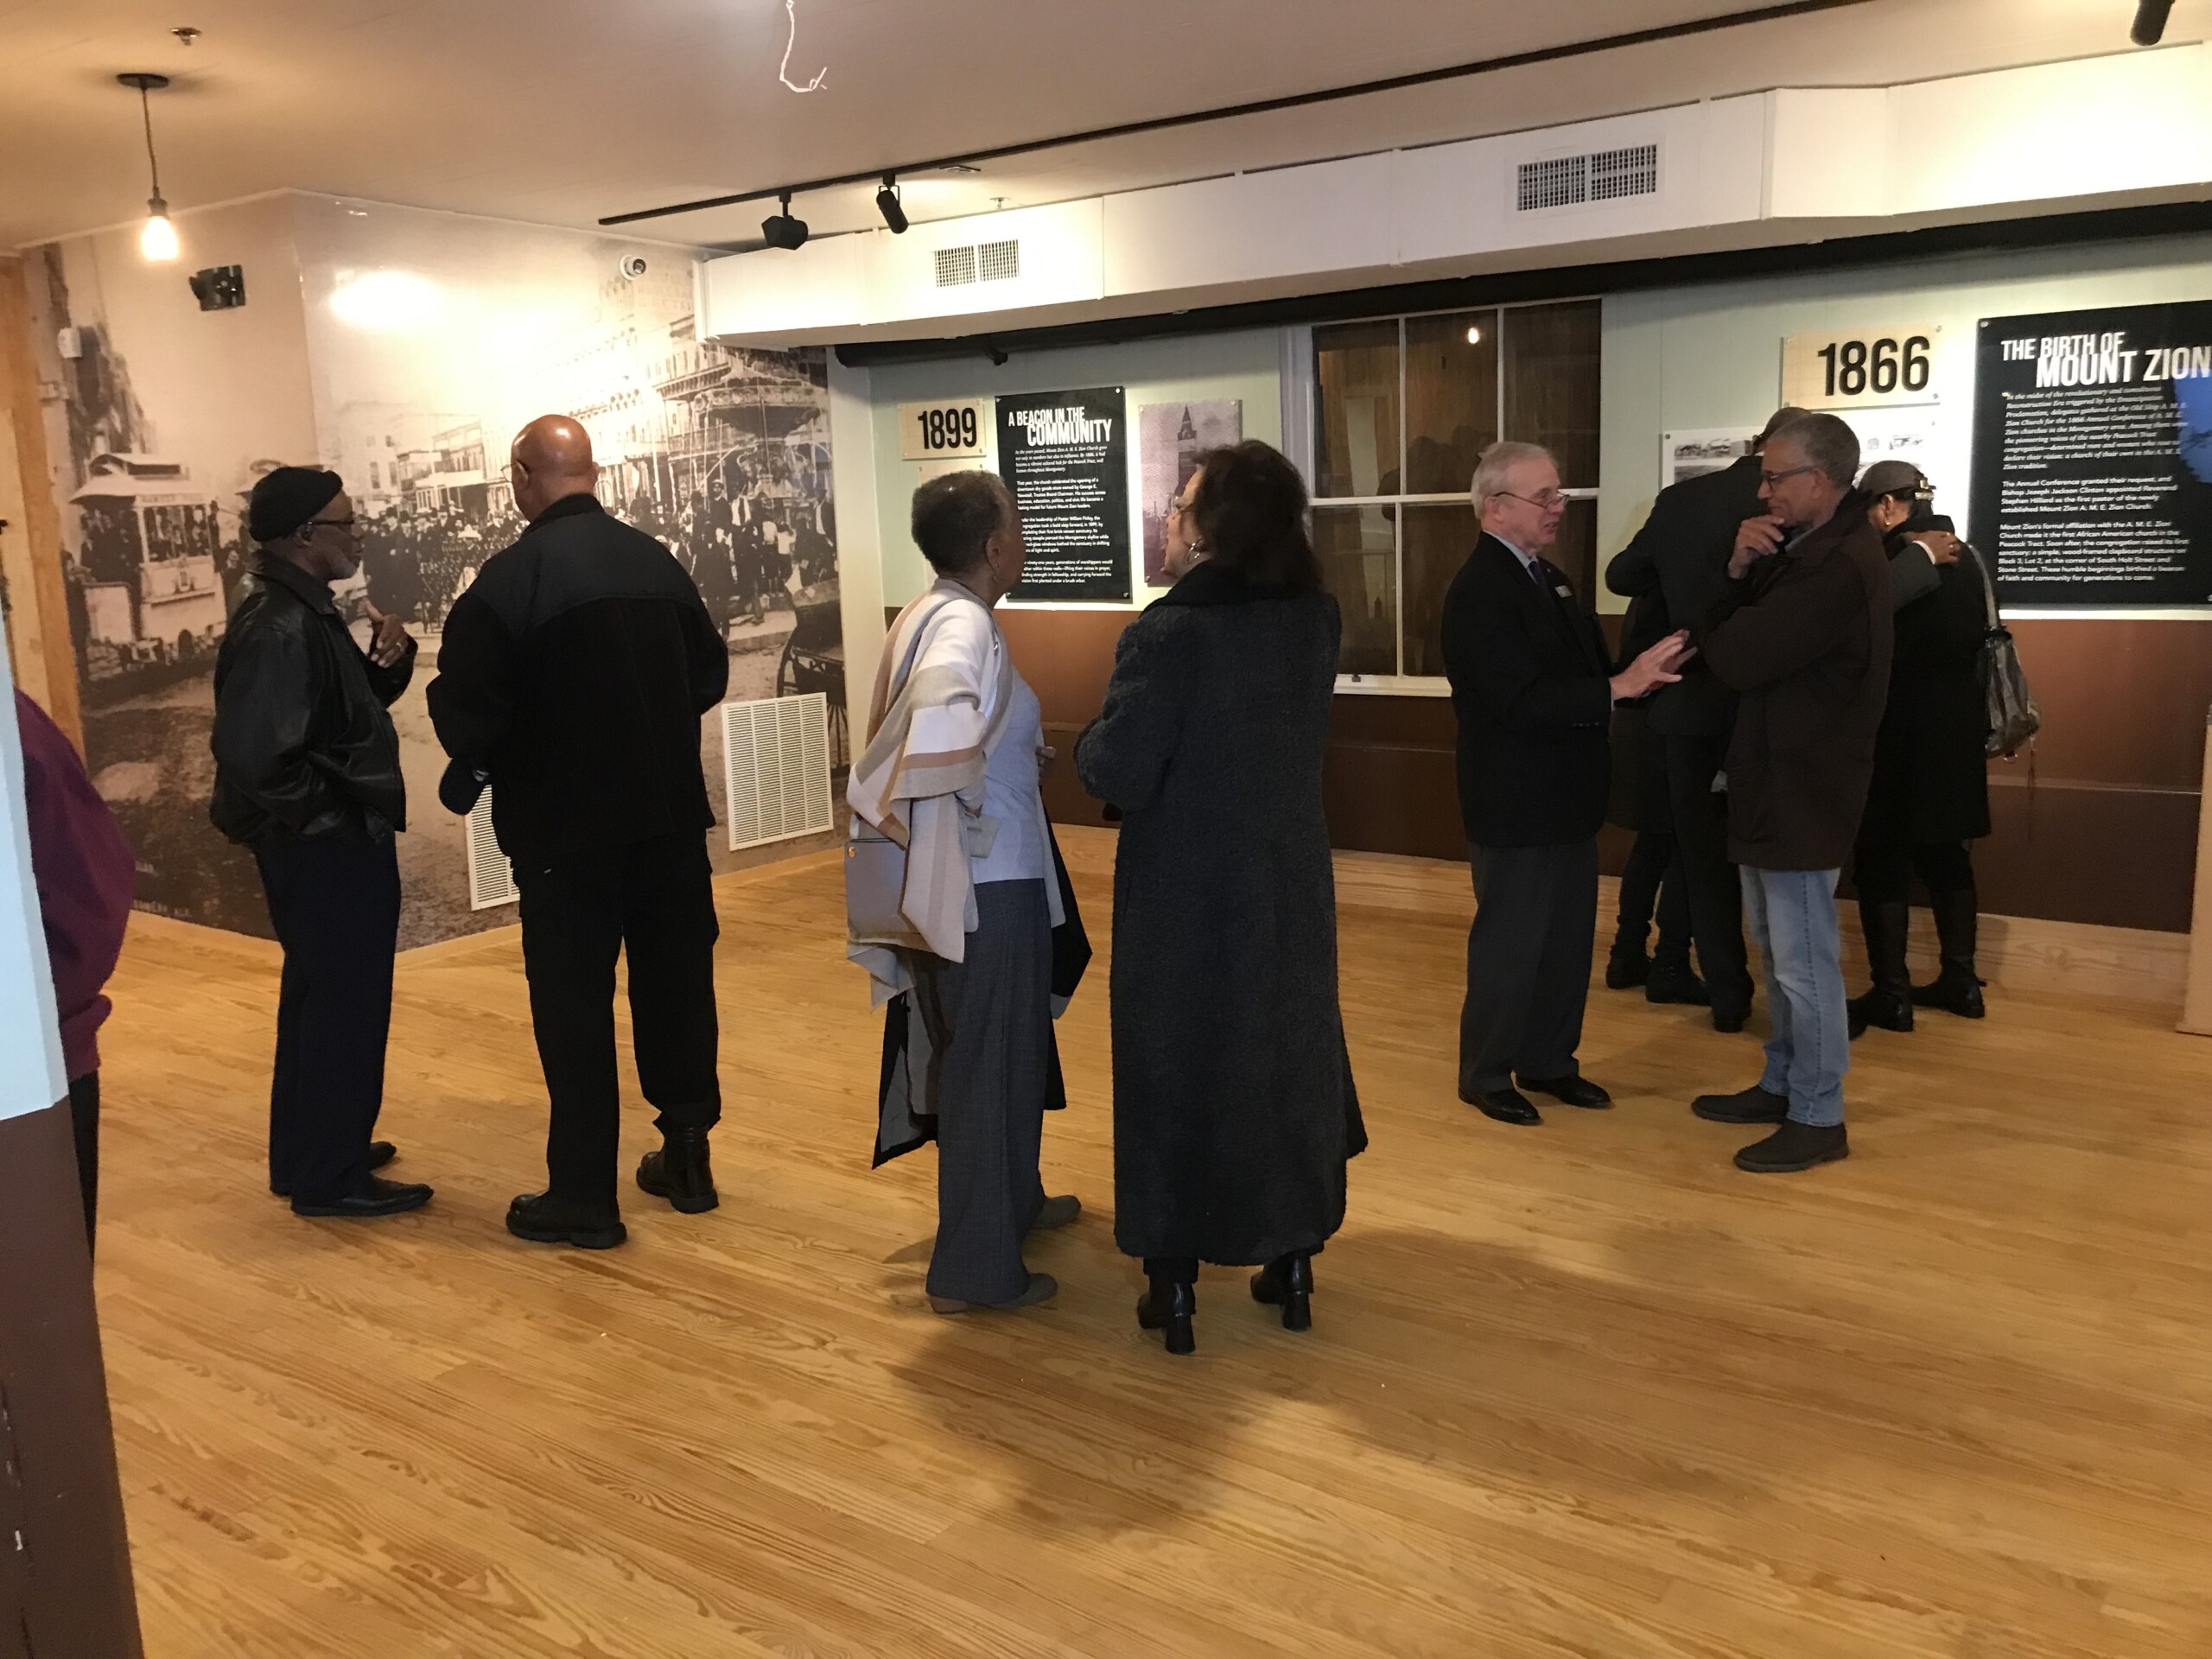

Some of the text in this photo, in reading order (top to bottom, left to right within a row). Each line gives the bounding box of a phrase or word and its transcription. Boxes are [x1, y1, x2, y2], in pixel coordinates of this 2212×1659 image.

[2001, 332, 2126, 361] THE BIRTH OF
[1817, 335, 1930, 397] 1866
[2036, 346, 2212, 388] MOUNT ZION
[918, 407, 977, 449] 1899
[1008, 406, 1085, 427] A BEACON IN THE
[1027, 419, 1112, 447] COMMUNITY
